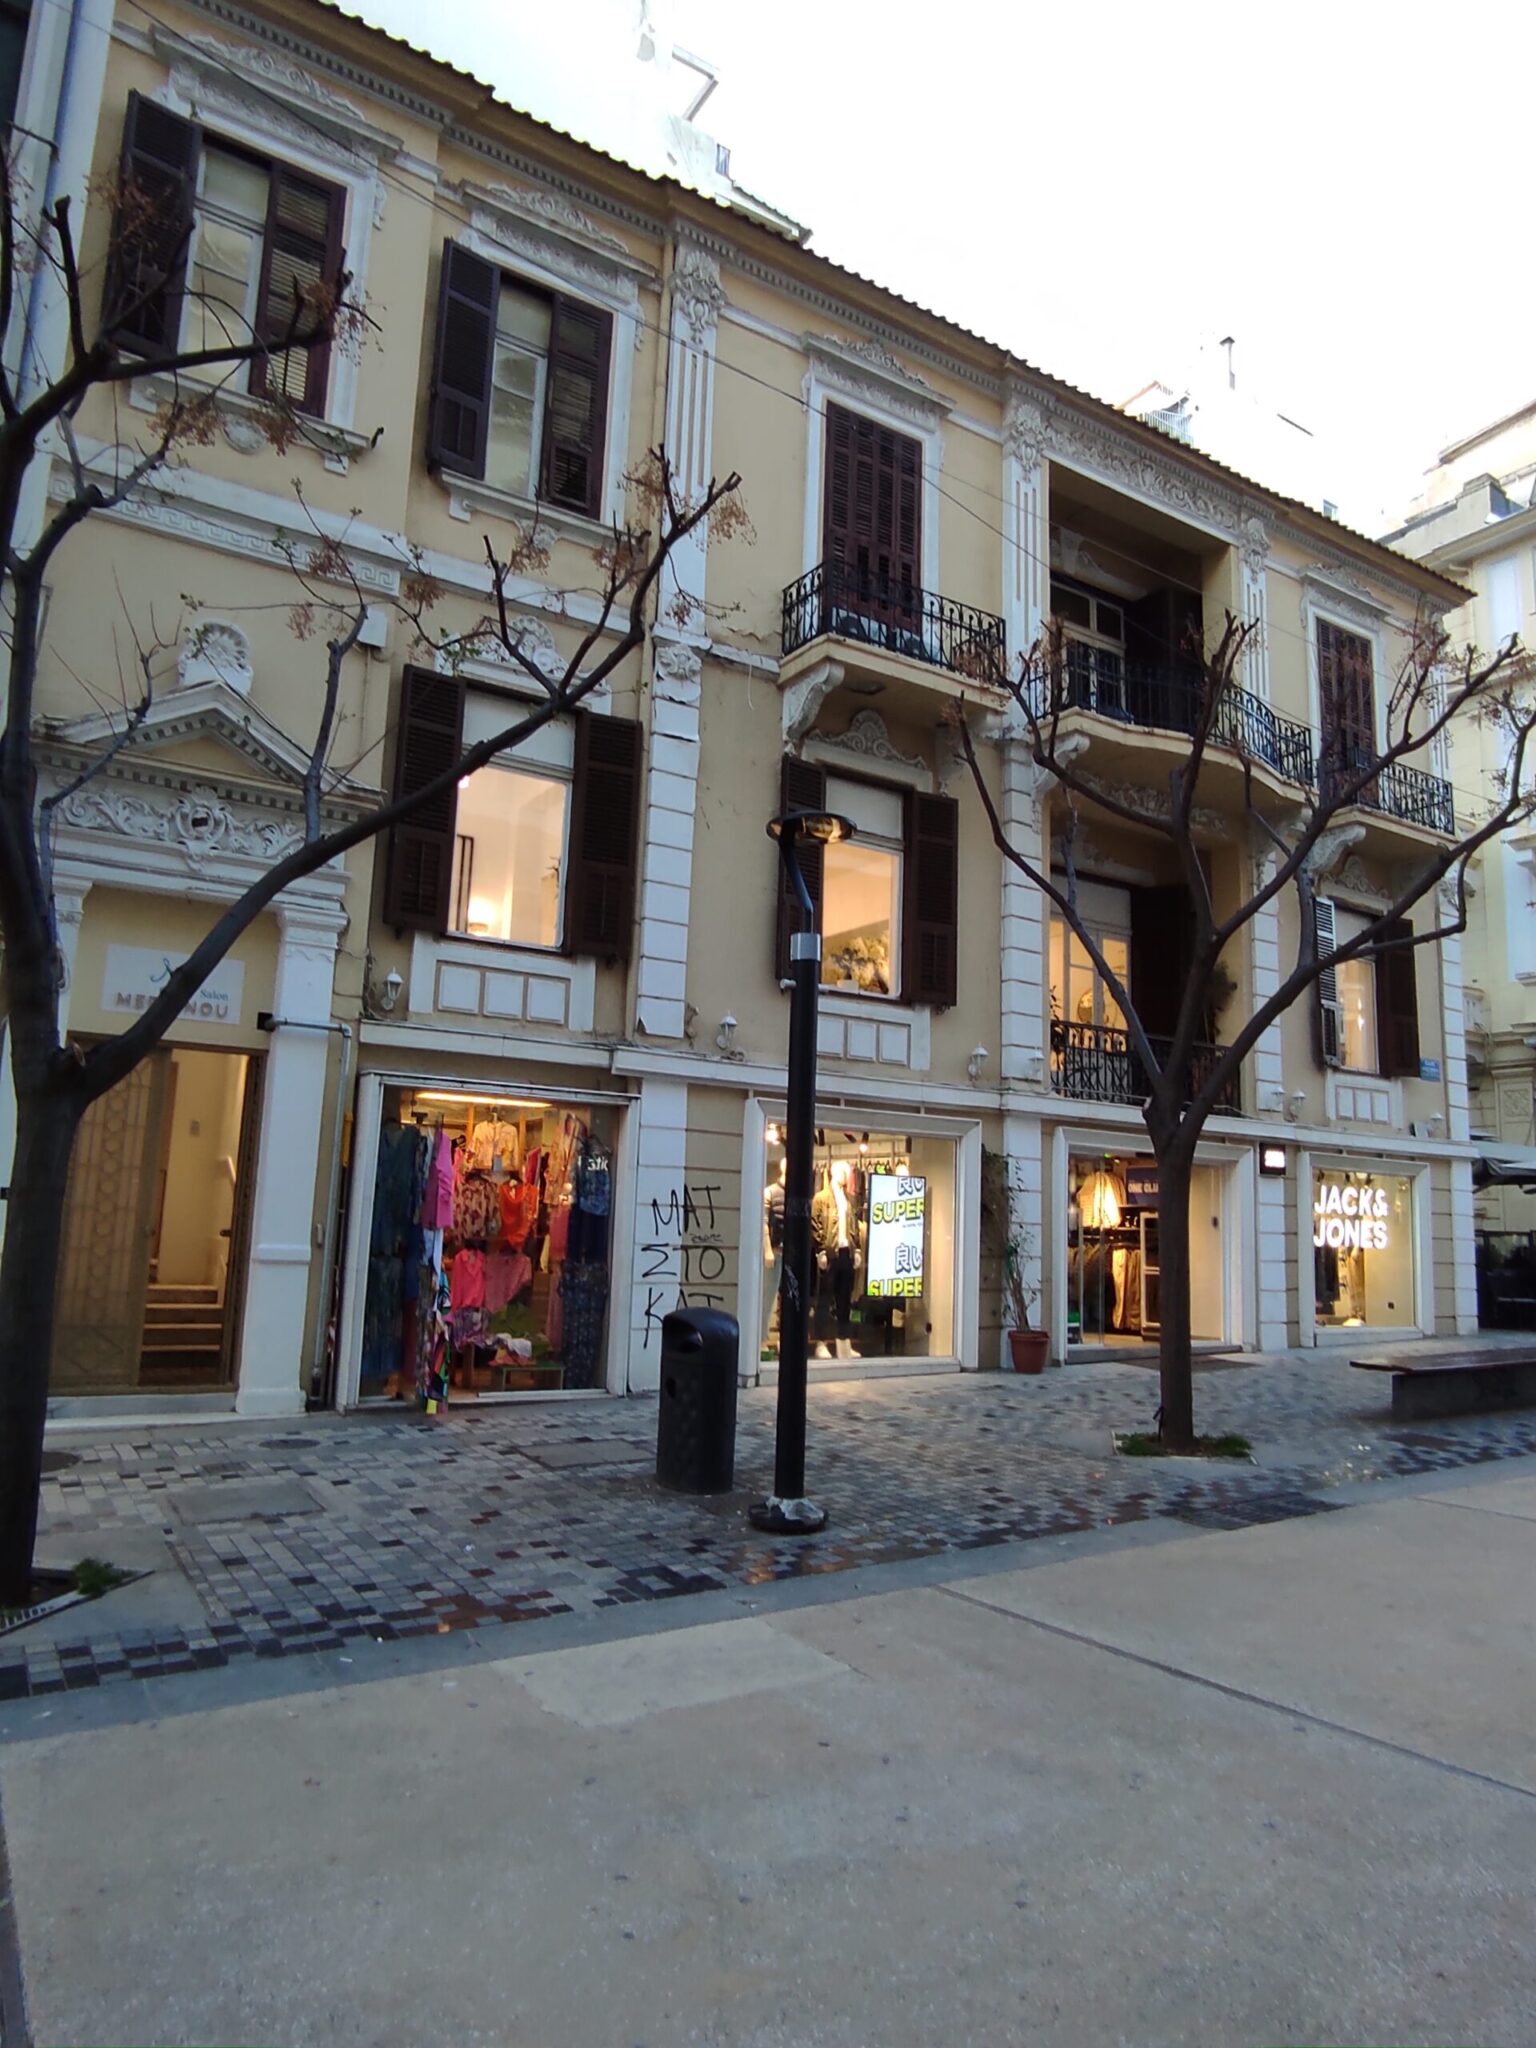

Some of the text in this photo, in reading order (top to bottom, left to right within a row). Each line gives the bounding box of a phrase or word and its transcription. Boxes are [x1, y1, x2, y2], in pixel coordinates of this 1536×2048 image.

[200, 989, 229, 1001] Salon
[1314, 1184, 1388, 1217] JACK&
[1313, 1216, 1388, 1250] JONES
